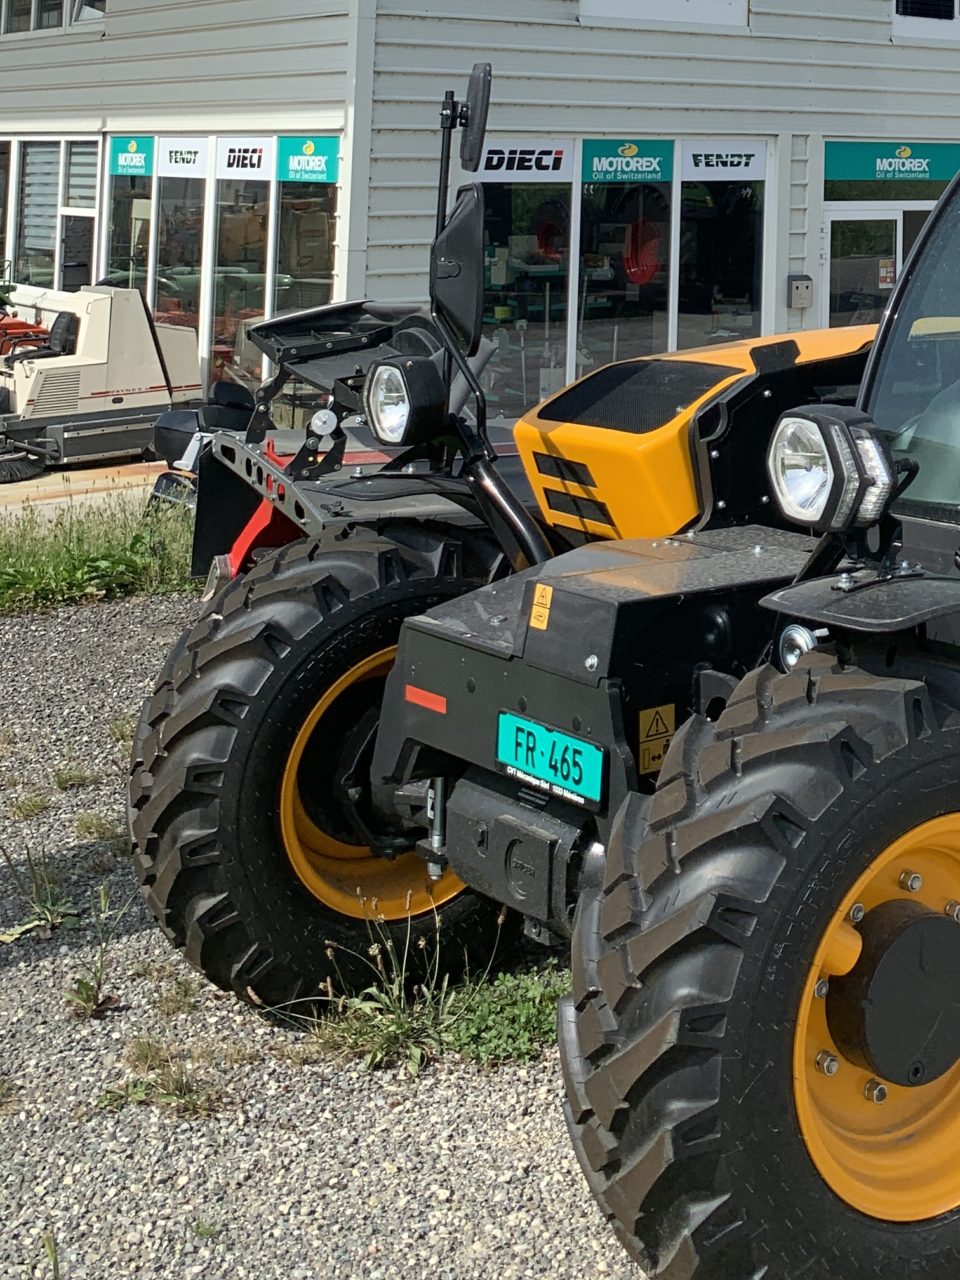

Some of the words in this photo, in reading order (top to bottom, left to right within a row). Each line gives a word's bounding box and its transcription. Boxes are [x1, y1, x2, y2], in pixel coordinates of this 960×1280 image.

[118, 152, 146, 166] MOTOREX
[168, 149, 199, 164] FENDT
[226, 147, 263, 169] DIECI
[288, 155, 328, 171] MOTOREX
[483, 149, 564, 171] DIECI
[592, 156, 661, 172] MOTOREX
[691, 153, 756, 168] FENDT
[875, 158, 930, 171] MOTOREX
[592, 171, 605, 180] Oil
[606, 171, 615, 180] of
[616, 171, 662, 180] Switzerland
[875, 171, 886, 179] Oil
[886, 171, 893, 179] of
[894, 171, 930, 179] Switzerland
[514, 725, 536, 769] FR
[548, 739, 583, 786] 465
